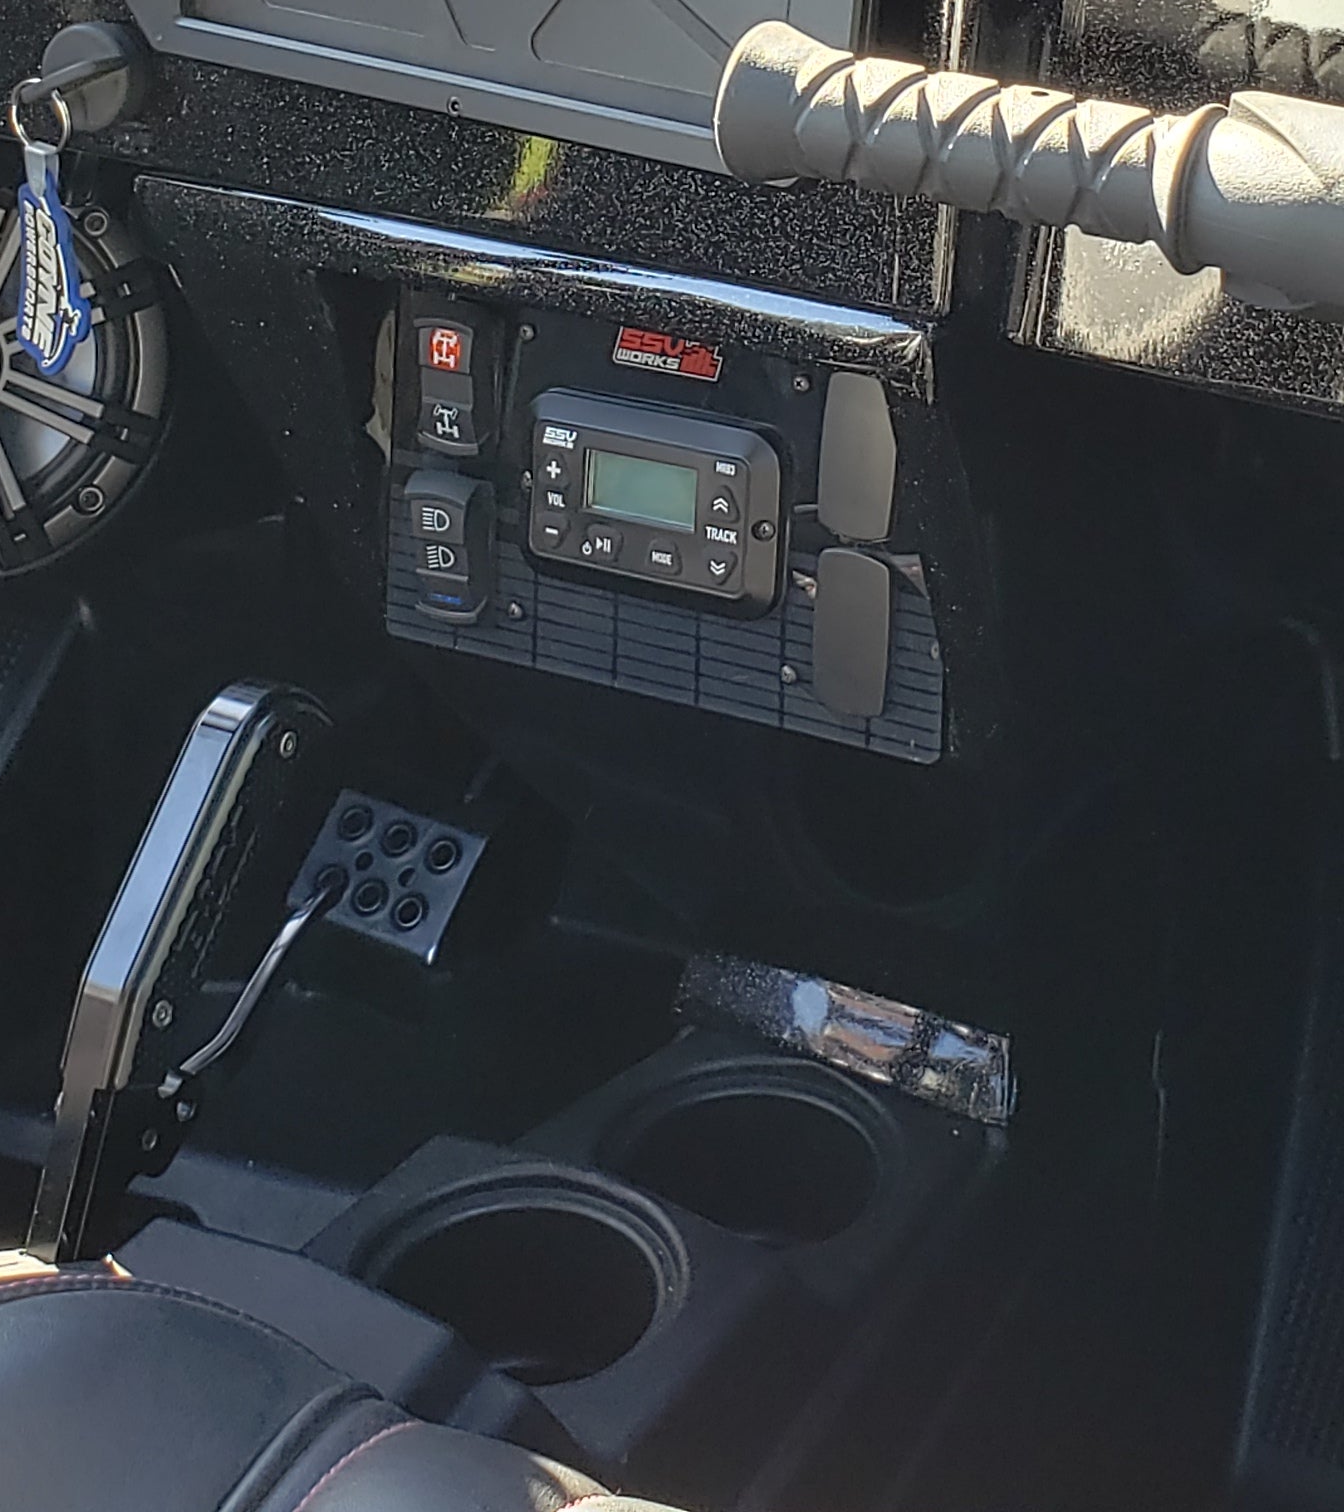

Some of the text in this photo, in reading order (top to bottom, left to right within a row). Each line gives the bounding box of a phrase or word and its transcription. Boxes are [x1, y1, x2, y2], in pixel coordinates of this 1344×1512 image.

[619, 328, 685, 357] SSV
[616, 348, 680, 370] WORKS
[545, 426, 578, 441] SSV
[547, 491, 566, 508] VOL
[705, 526, 737, 544] TRACK
